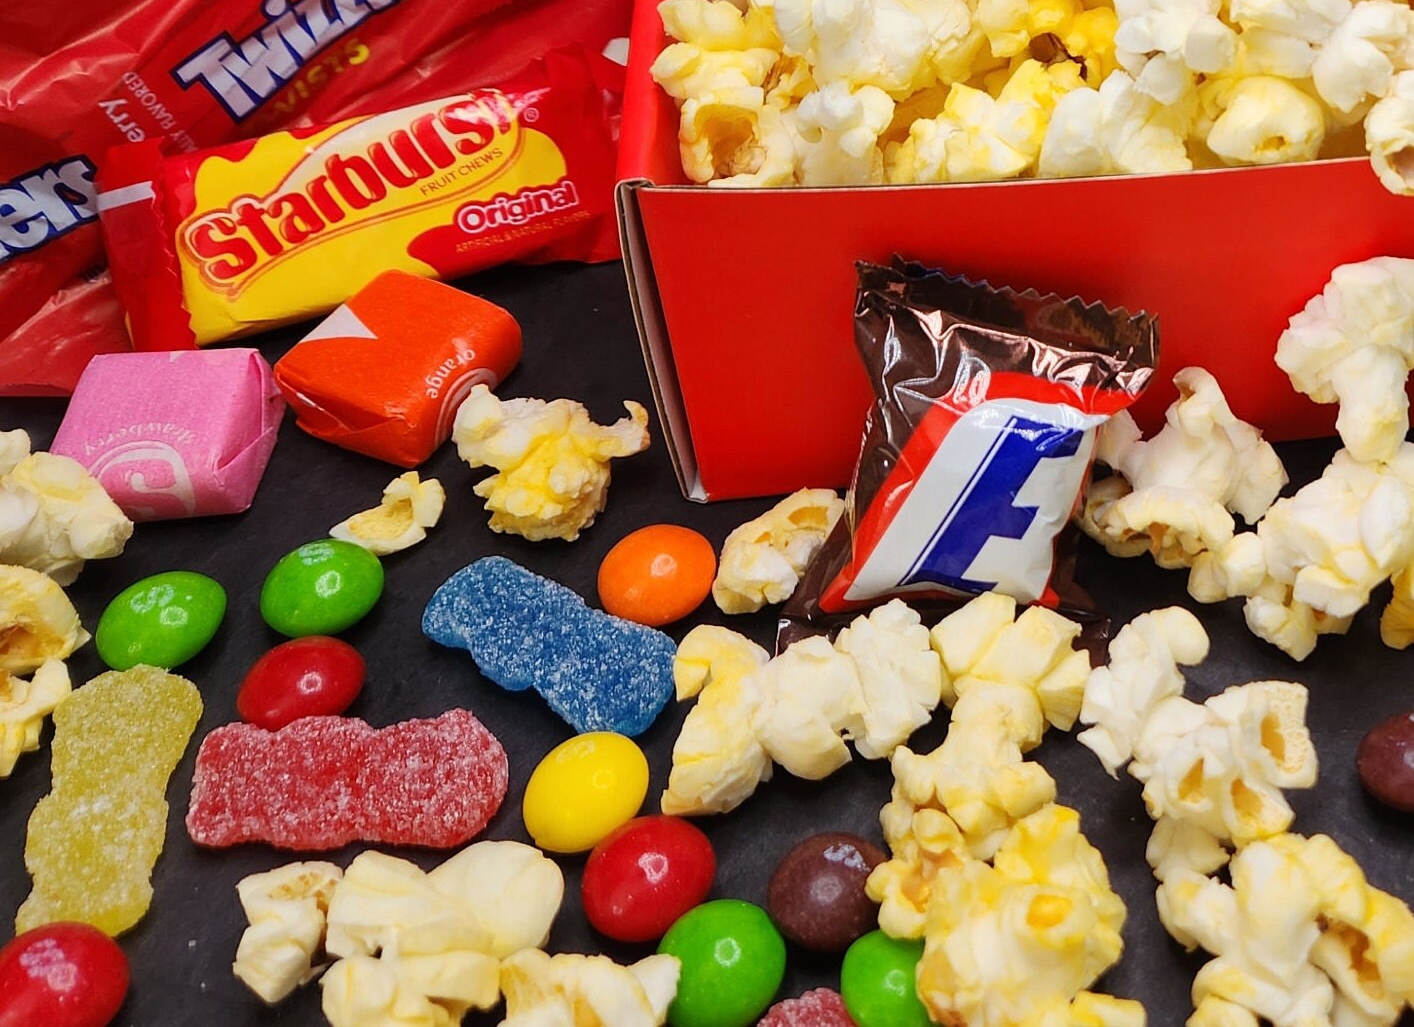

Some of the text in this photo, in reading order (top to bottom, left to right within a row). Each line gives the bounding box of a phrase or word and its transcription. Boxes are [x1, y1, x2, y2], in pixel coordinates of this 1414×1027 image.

[122, 70, 177, 131] FLAVORED
[419, 147, 504, 197] FRUIT CHEWS
[457, 180, 579, 235] Original
